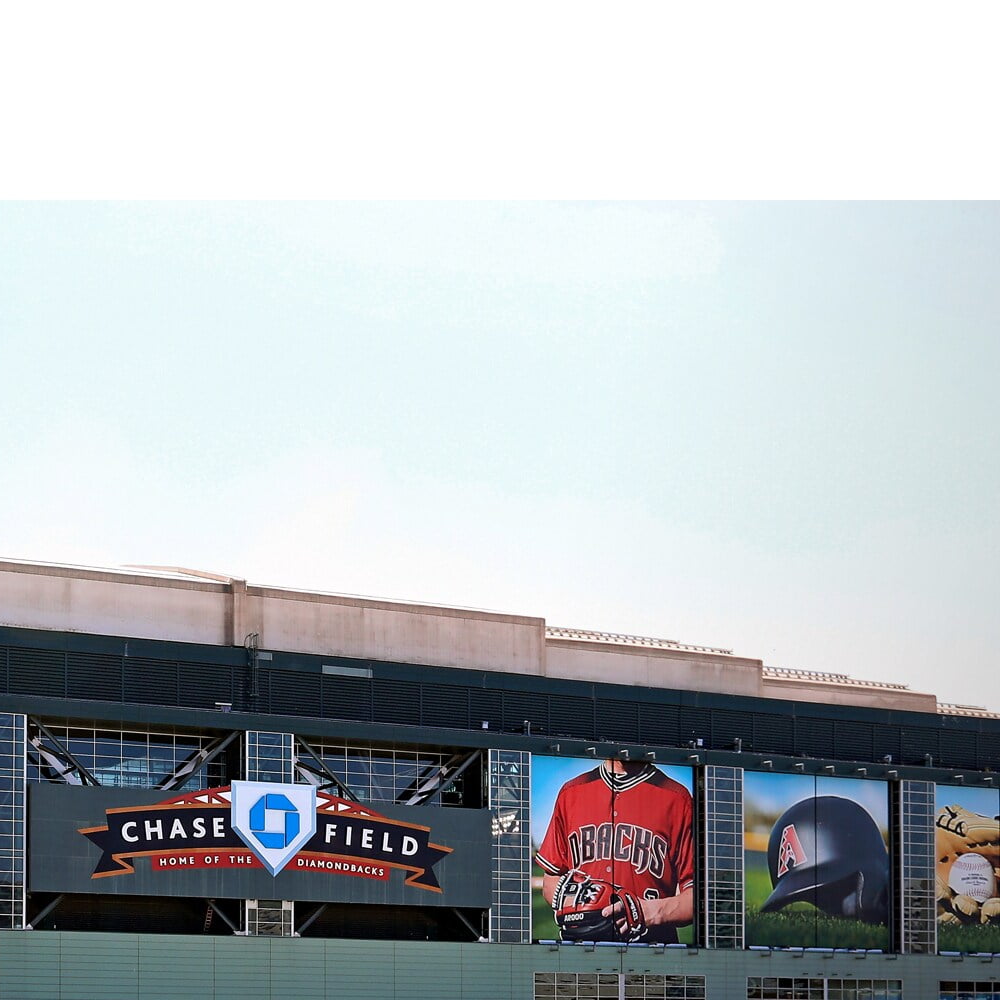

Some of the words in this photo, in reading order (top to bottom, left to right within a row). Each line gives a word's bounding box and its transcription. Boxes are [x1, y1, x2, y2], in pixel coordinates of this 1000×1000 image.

[121, 817, 226, 843] CHASE
[324, 823, 419, 856] FIELD
[159, 856, 195, 866] HOME
[204, 855, 220, 864] OF
[229, 855, 252, 864] THE
[297, 858, 385, 877] DIAMONDBACKS
